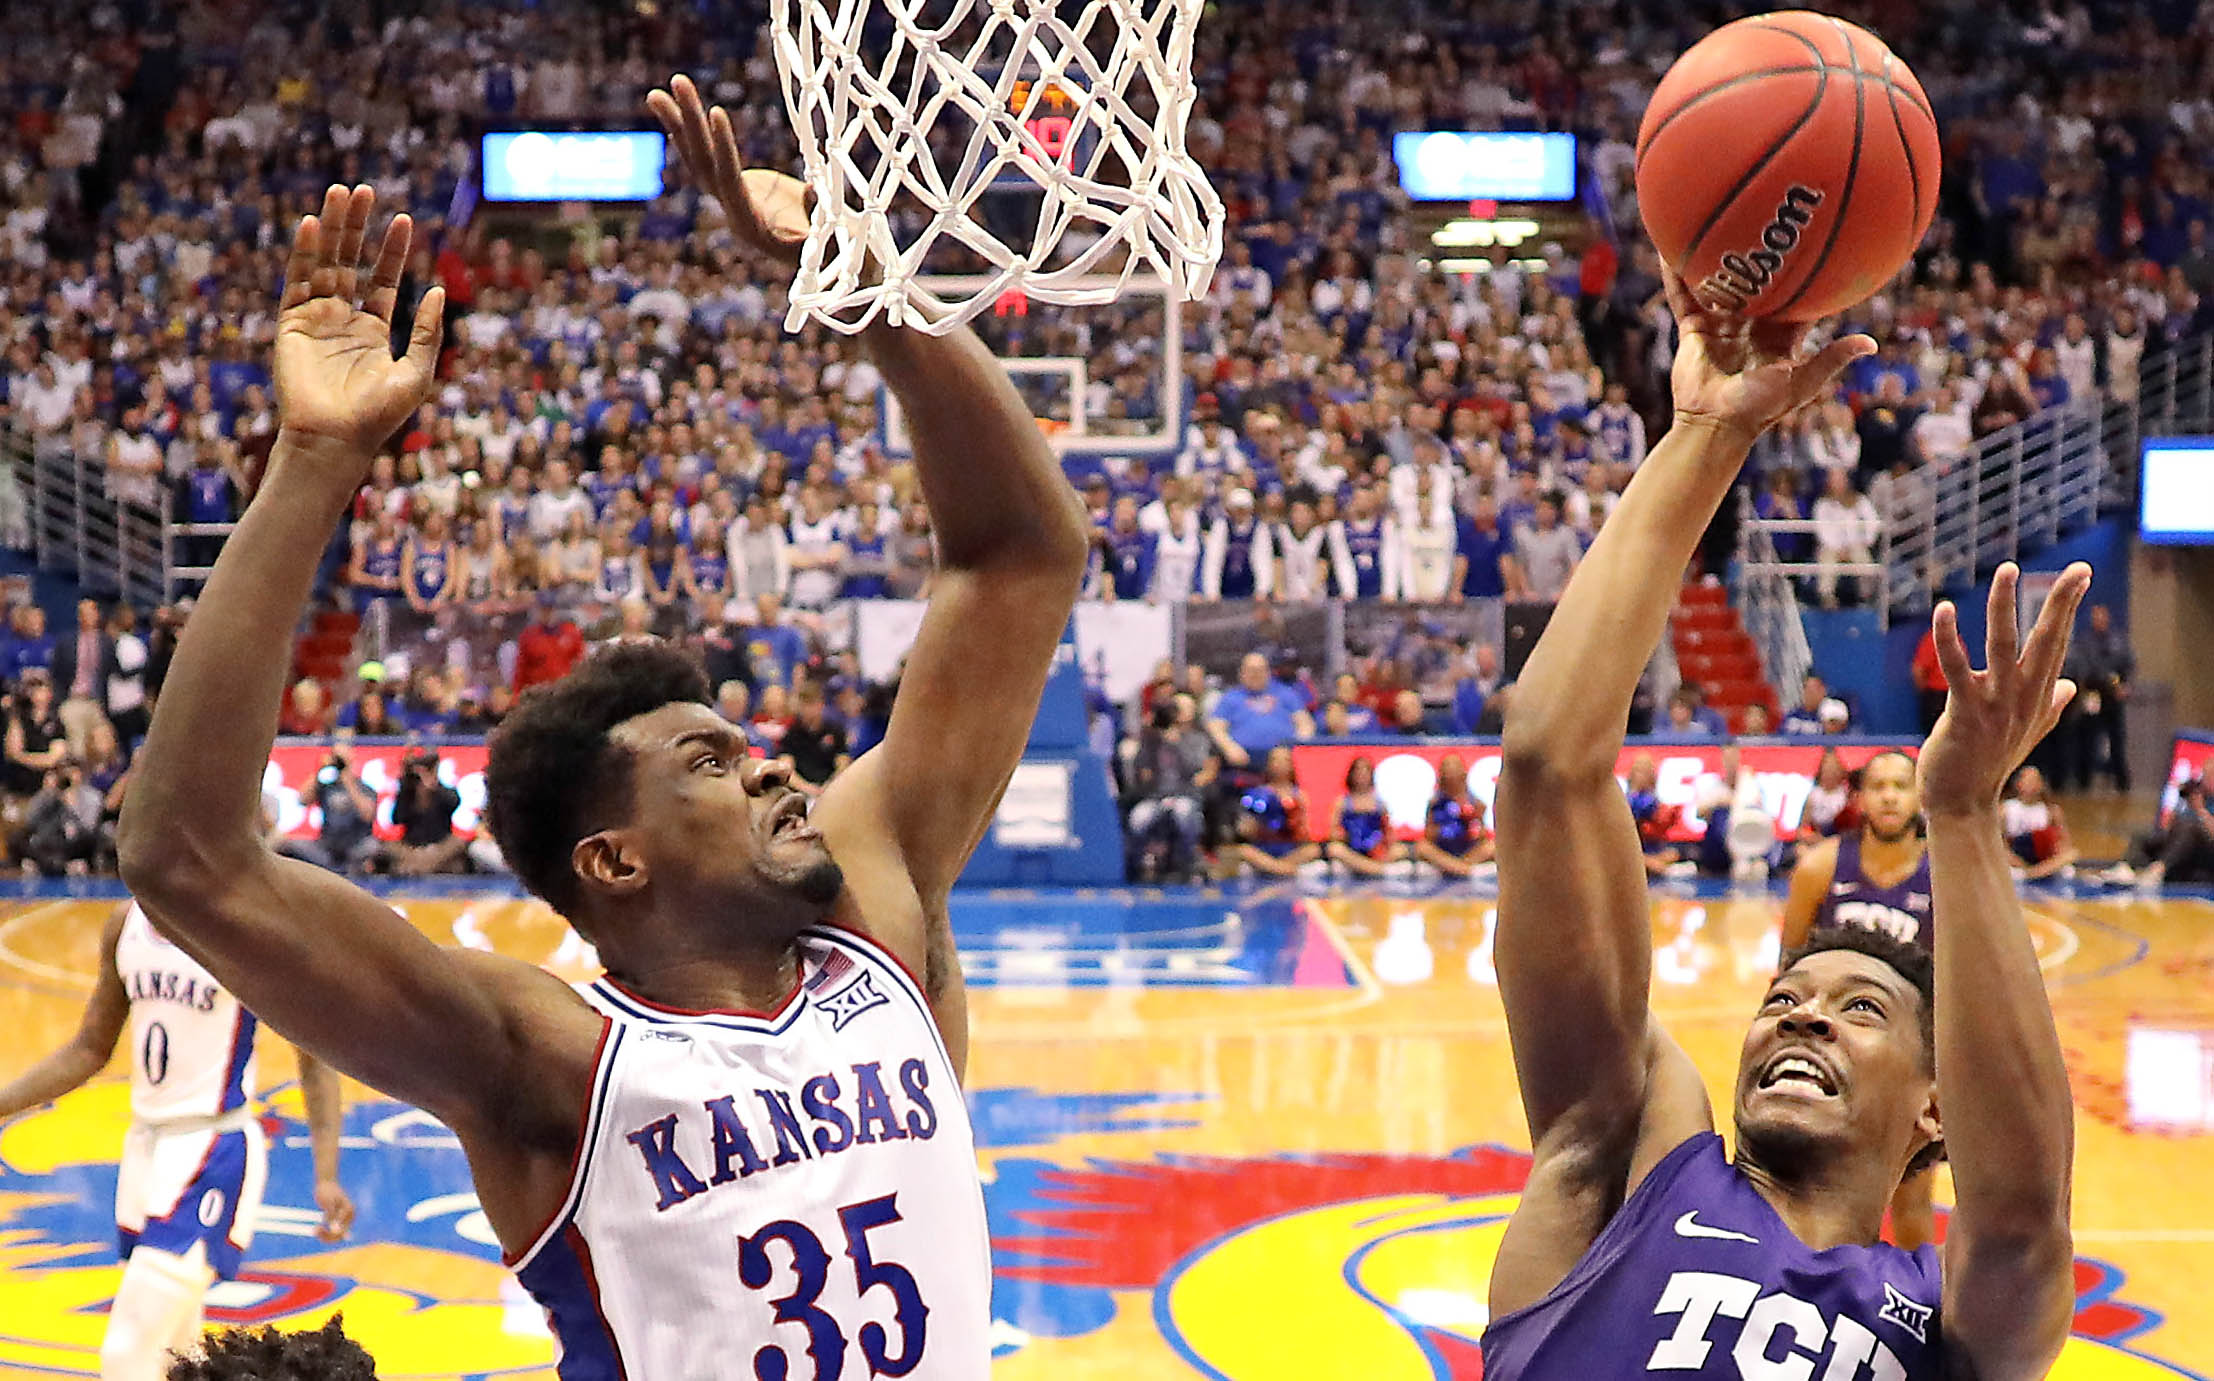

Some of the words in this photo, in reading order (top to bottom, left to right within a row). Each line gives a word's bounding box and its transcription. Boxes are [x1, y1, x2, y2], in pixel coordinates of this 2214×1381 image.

[122, 969, 218, 1012] ANSAS
[143, 1021, 169, 1087] 0
[626, 1057, 938, 1212] KANSAS
[737, 1191, 930, 1381] 35
